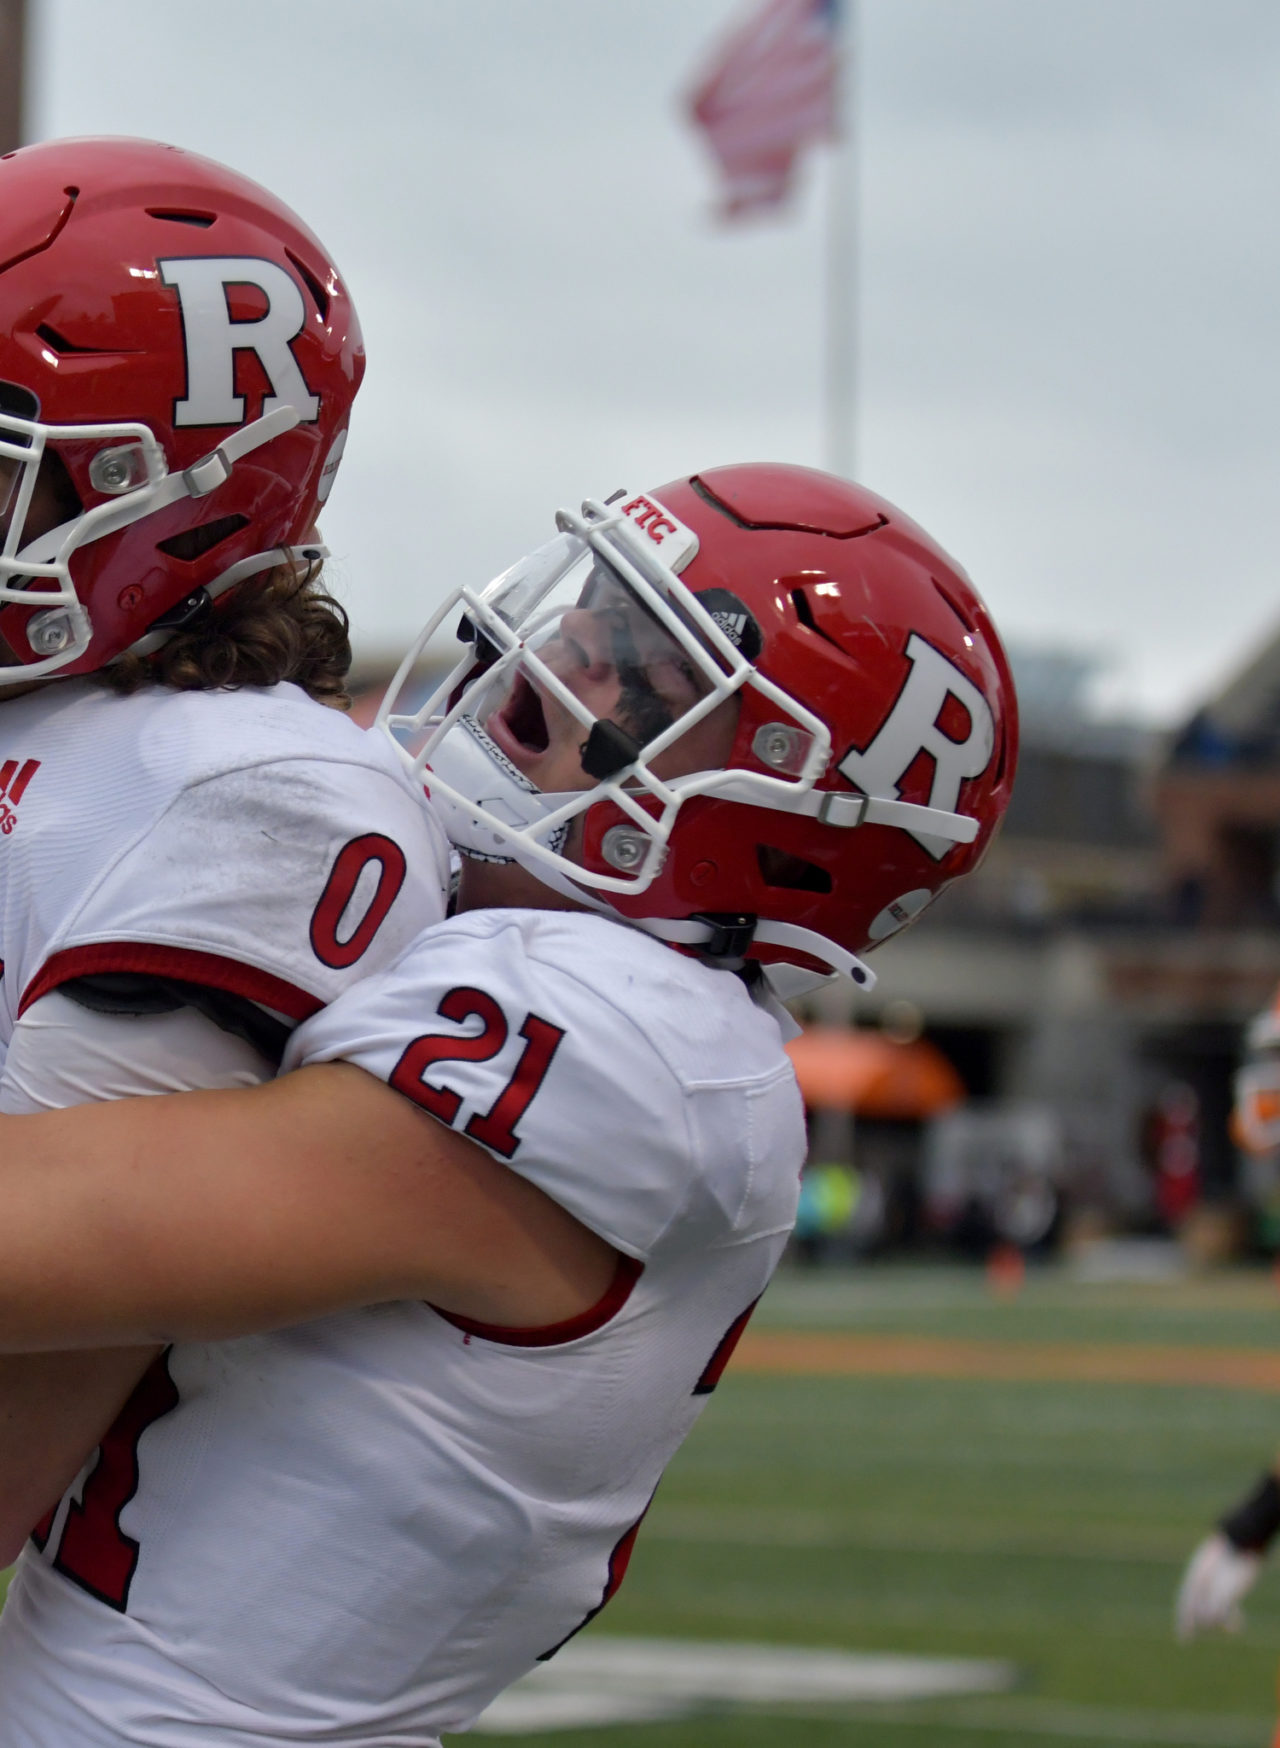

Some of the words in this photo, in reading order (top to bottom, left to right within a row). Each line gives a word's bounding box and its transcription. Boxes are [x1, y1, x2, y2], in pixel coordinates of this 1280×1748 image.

[157, 255, 320, 428] R
[835, 629, 996, 863] R
[309, 832, 407, 969] 0
[388, 986, 566, 1159] 21
